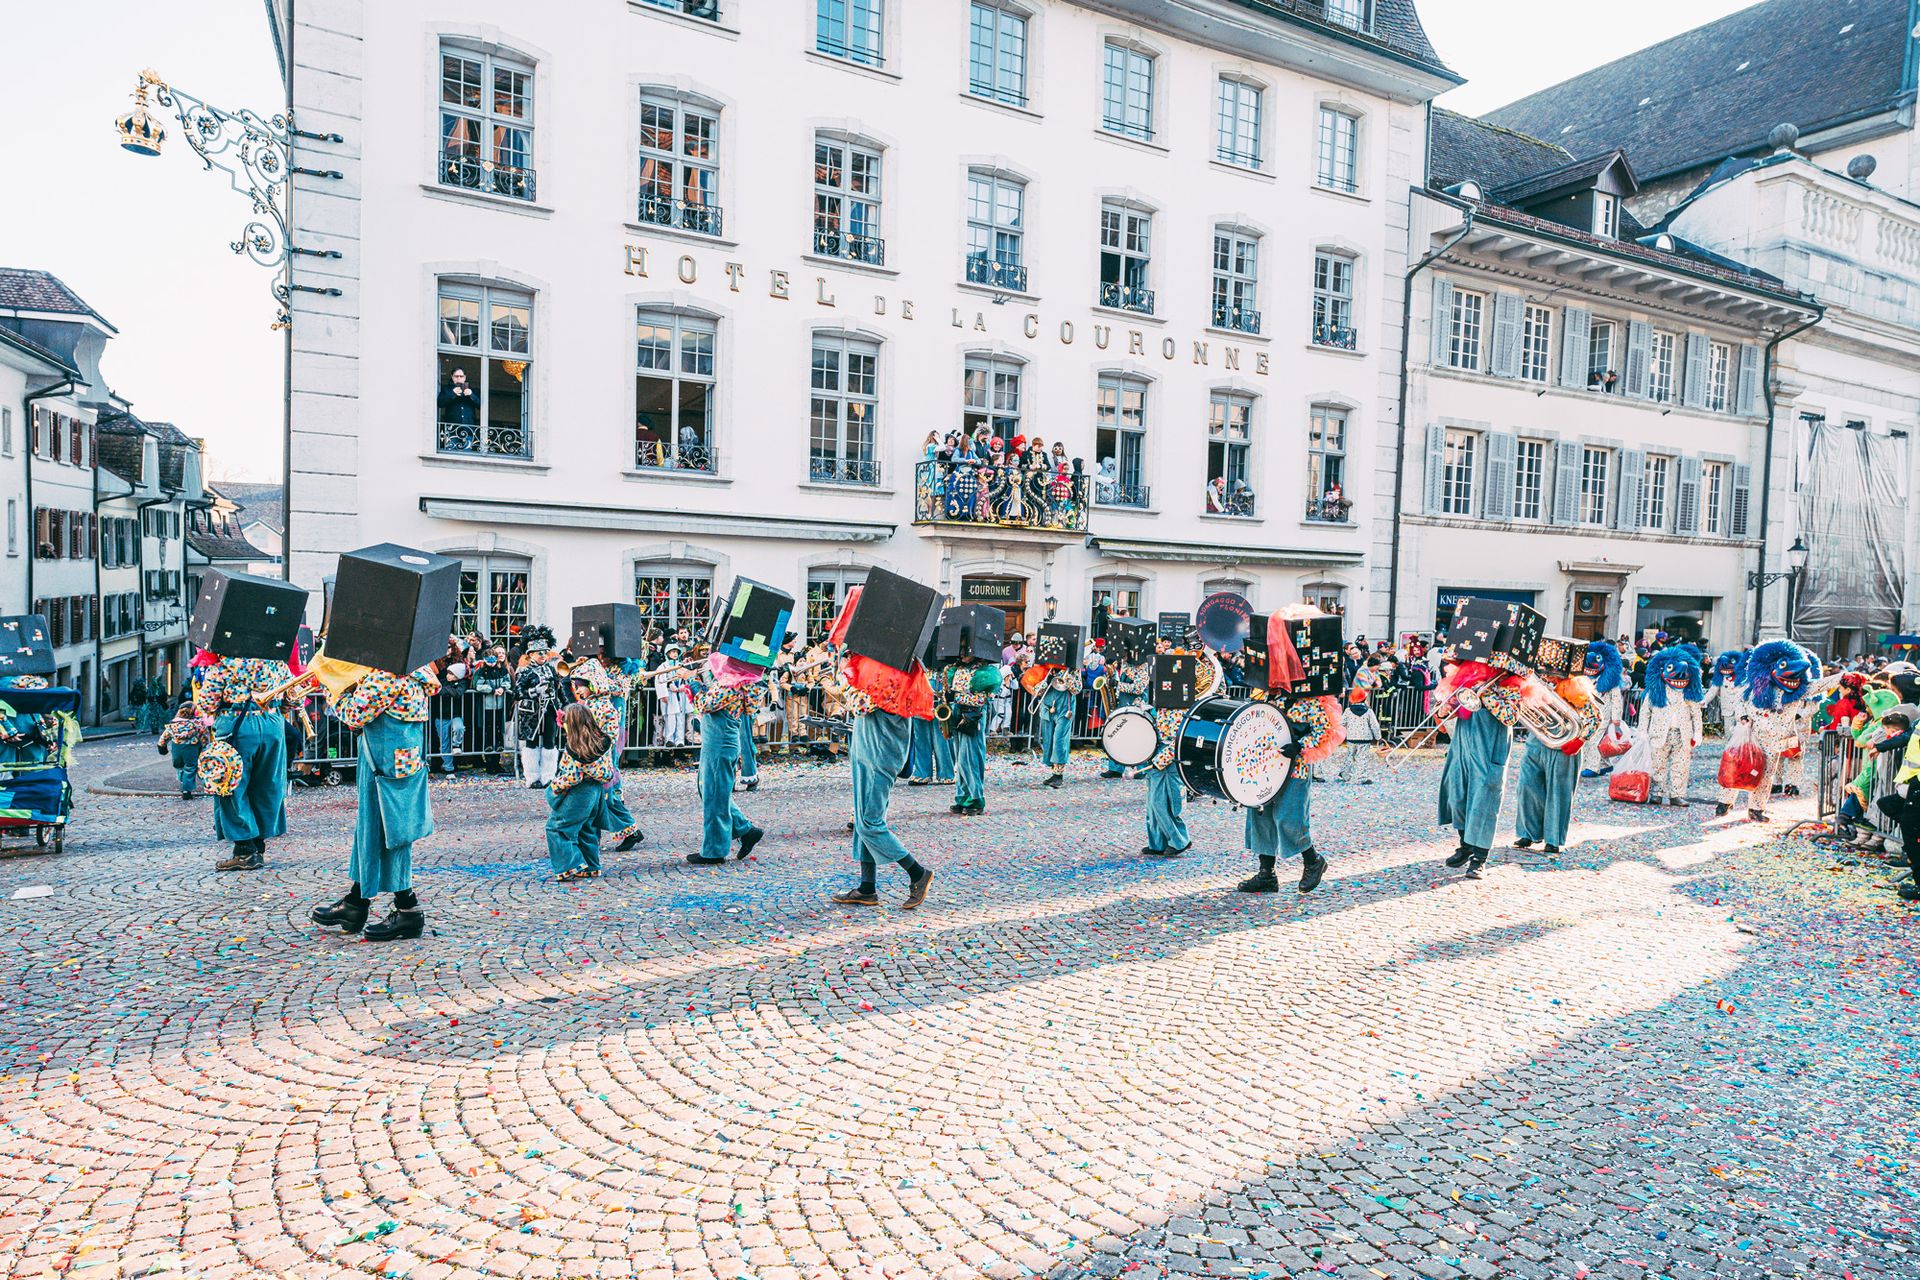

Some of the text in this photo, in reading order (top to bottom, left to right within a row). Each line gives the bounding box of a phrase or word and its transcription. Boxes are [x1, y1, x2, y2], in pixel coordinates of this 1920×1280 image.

[624, 244, 1269, 376] HOTEL DE LA COURONNE
[969, 584, 1011, 596] COURONNE
[1225, 709, 1283, 763] SUMGAGGOPHONIKER
